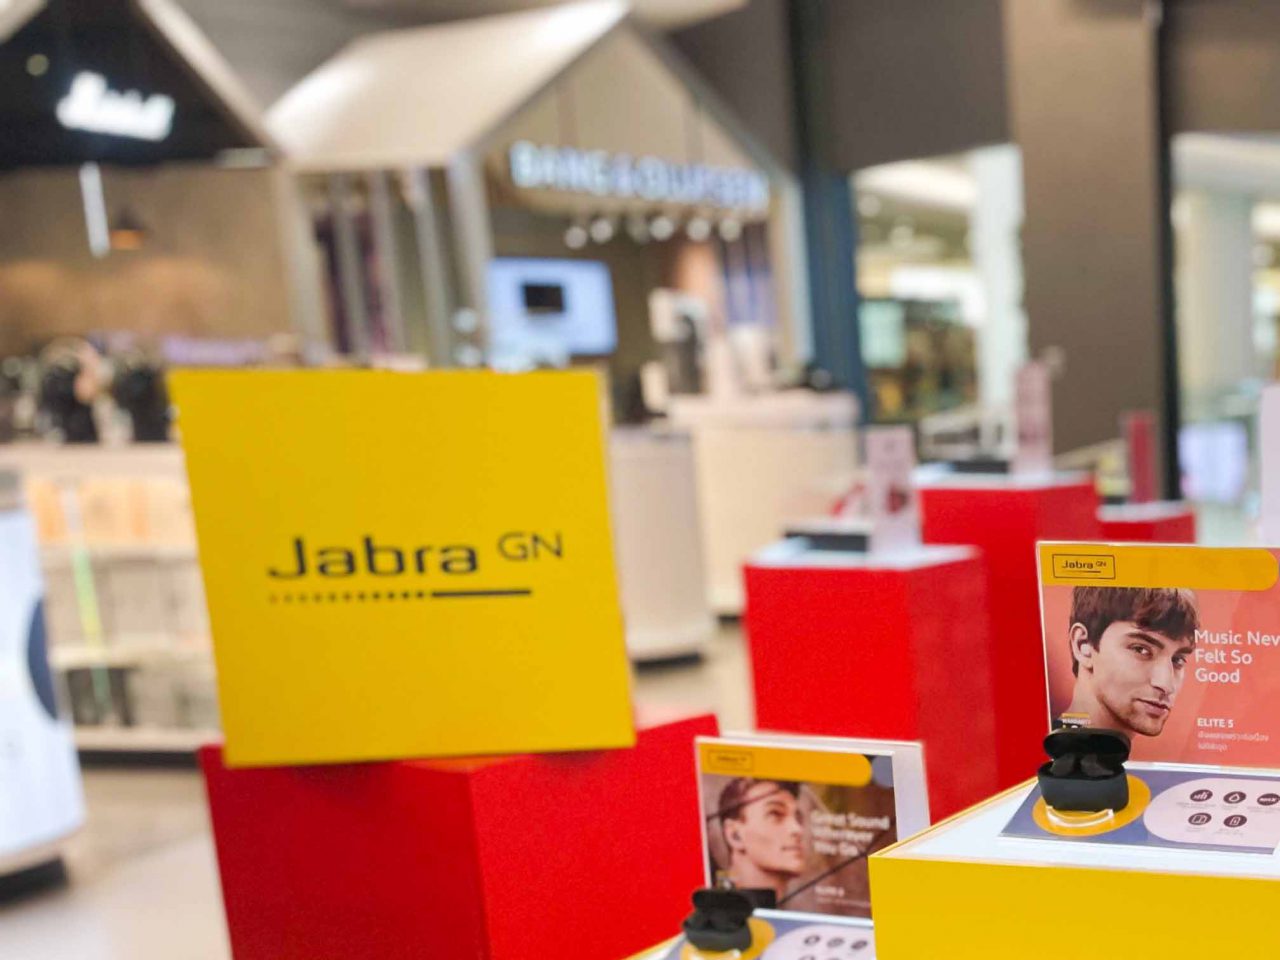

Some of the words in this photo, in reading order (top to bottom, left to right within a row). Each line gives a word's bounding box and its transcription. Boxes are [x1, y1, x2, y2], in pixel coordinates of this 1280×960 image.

[267, 535, 478, 579] Jabra
[498, 532, 563, 561] GN
[1194, 629, 1243, 645] Music
[1195, 648, 1226, 664] Felt
[1231, 649, 1252, 665] So
[1195, 667, 1240, 683] Good
[1197, 717, 1226, 728] ELITE
[1228, 719, 1234, 728] 5
